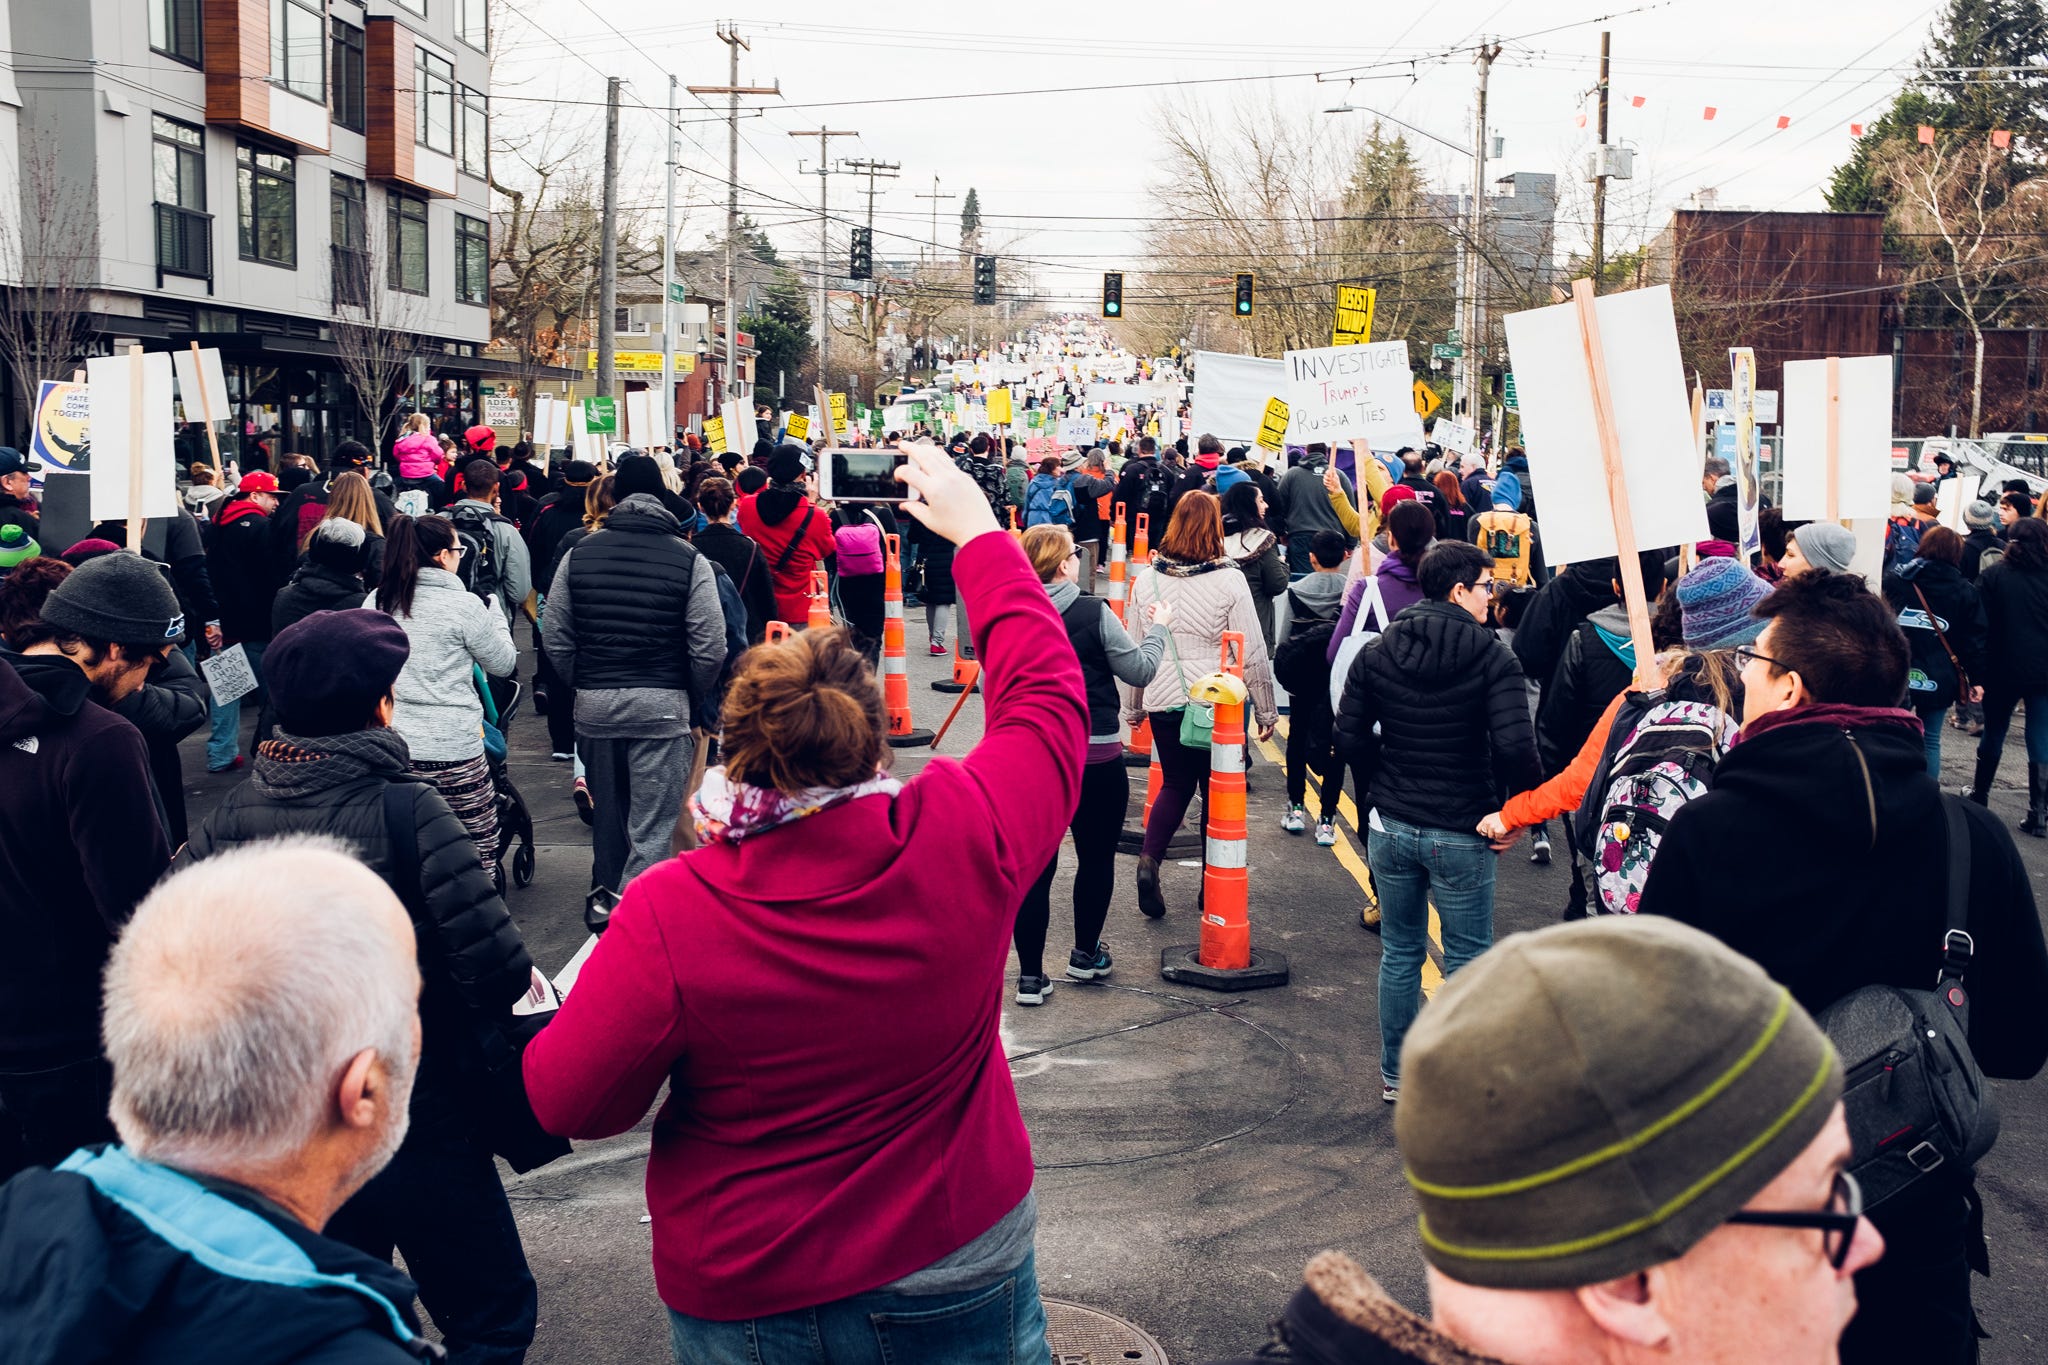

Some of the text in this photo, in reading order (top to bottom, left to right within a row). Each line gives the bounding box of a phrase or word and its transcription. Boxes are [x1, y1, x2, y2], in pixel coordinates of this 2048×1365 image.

[1340, 286, 1367, 311] RESIST
[1337, 309, 1366, 333] TRUMP
[27, 341, 109, 356] CENTRAL
[1293, 348, 1406, 381] INVESTIGATE
[53, 409, 90, 418] TOGETH
[66, 402, 89, 410] COME
